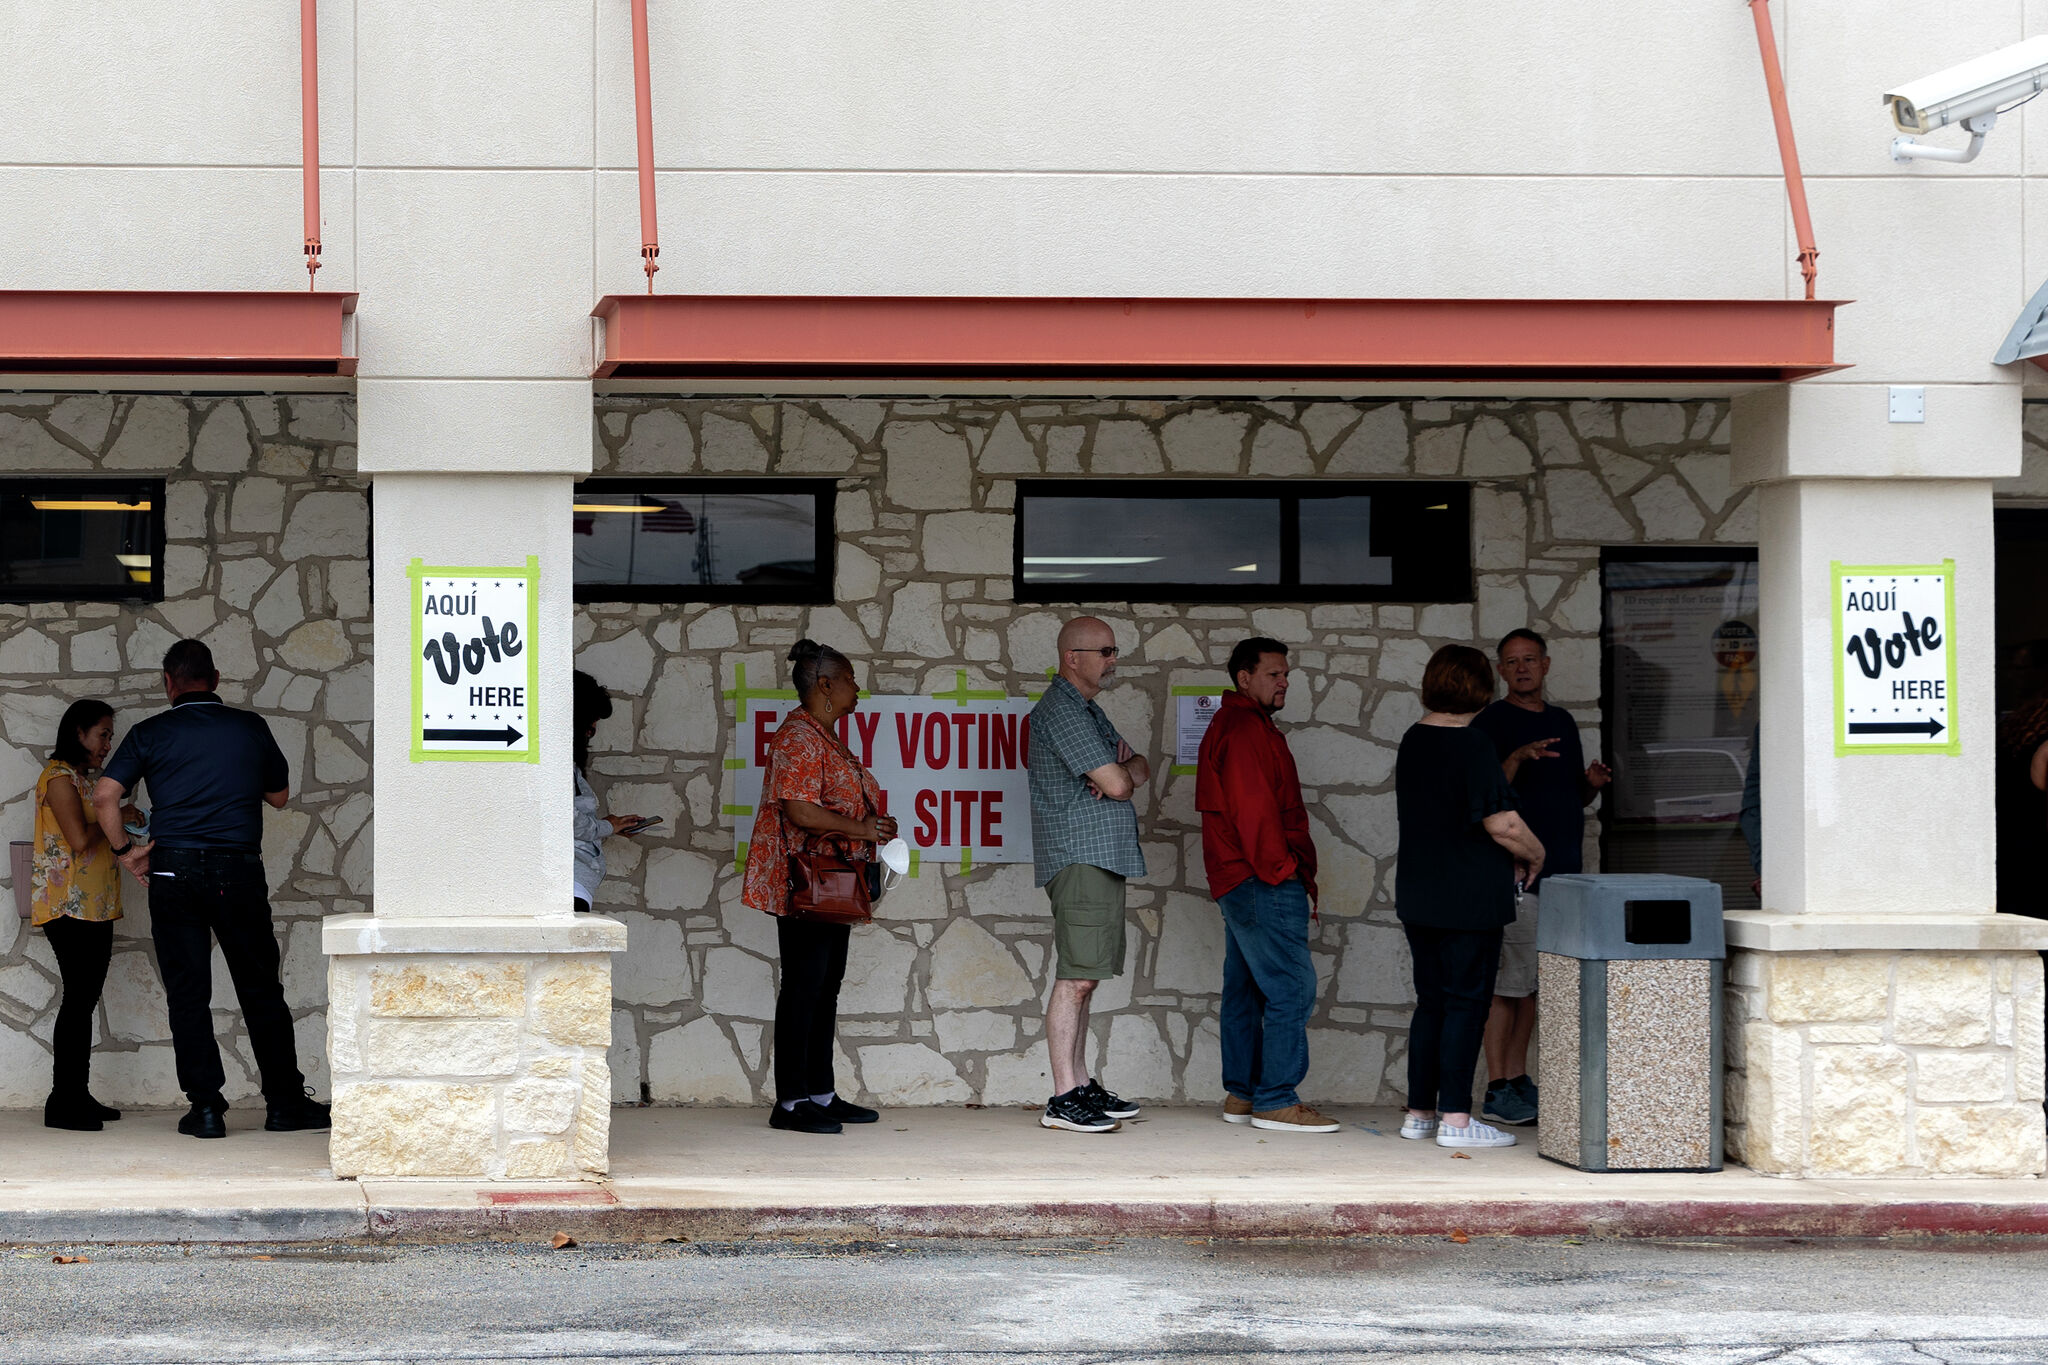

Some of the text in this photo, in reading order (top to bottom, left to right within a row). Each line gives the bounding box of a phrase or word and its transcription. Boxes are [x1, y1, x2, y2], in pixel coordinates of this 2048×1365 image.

[424, 590, 477, 616] AQUÍ
[1846, 586, 1896, 612] AQUÍ
[423, 616, 522, 685] Vote
[1847, 611, 1942, 679] Vote
[469, 687, 524, 707] HERE
[1892, 680, 1945, 700] HERE
[914, 788, 1003, 847] SITE
